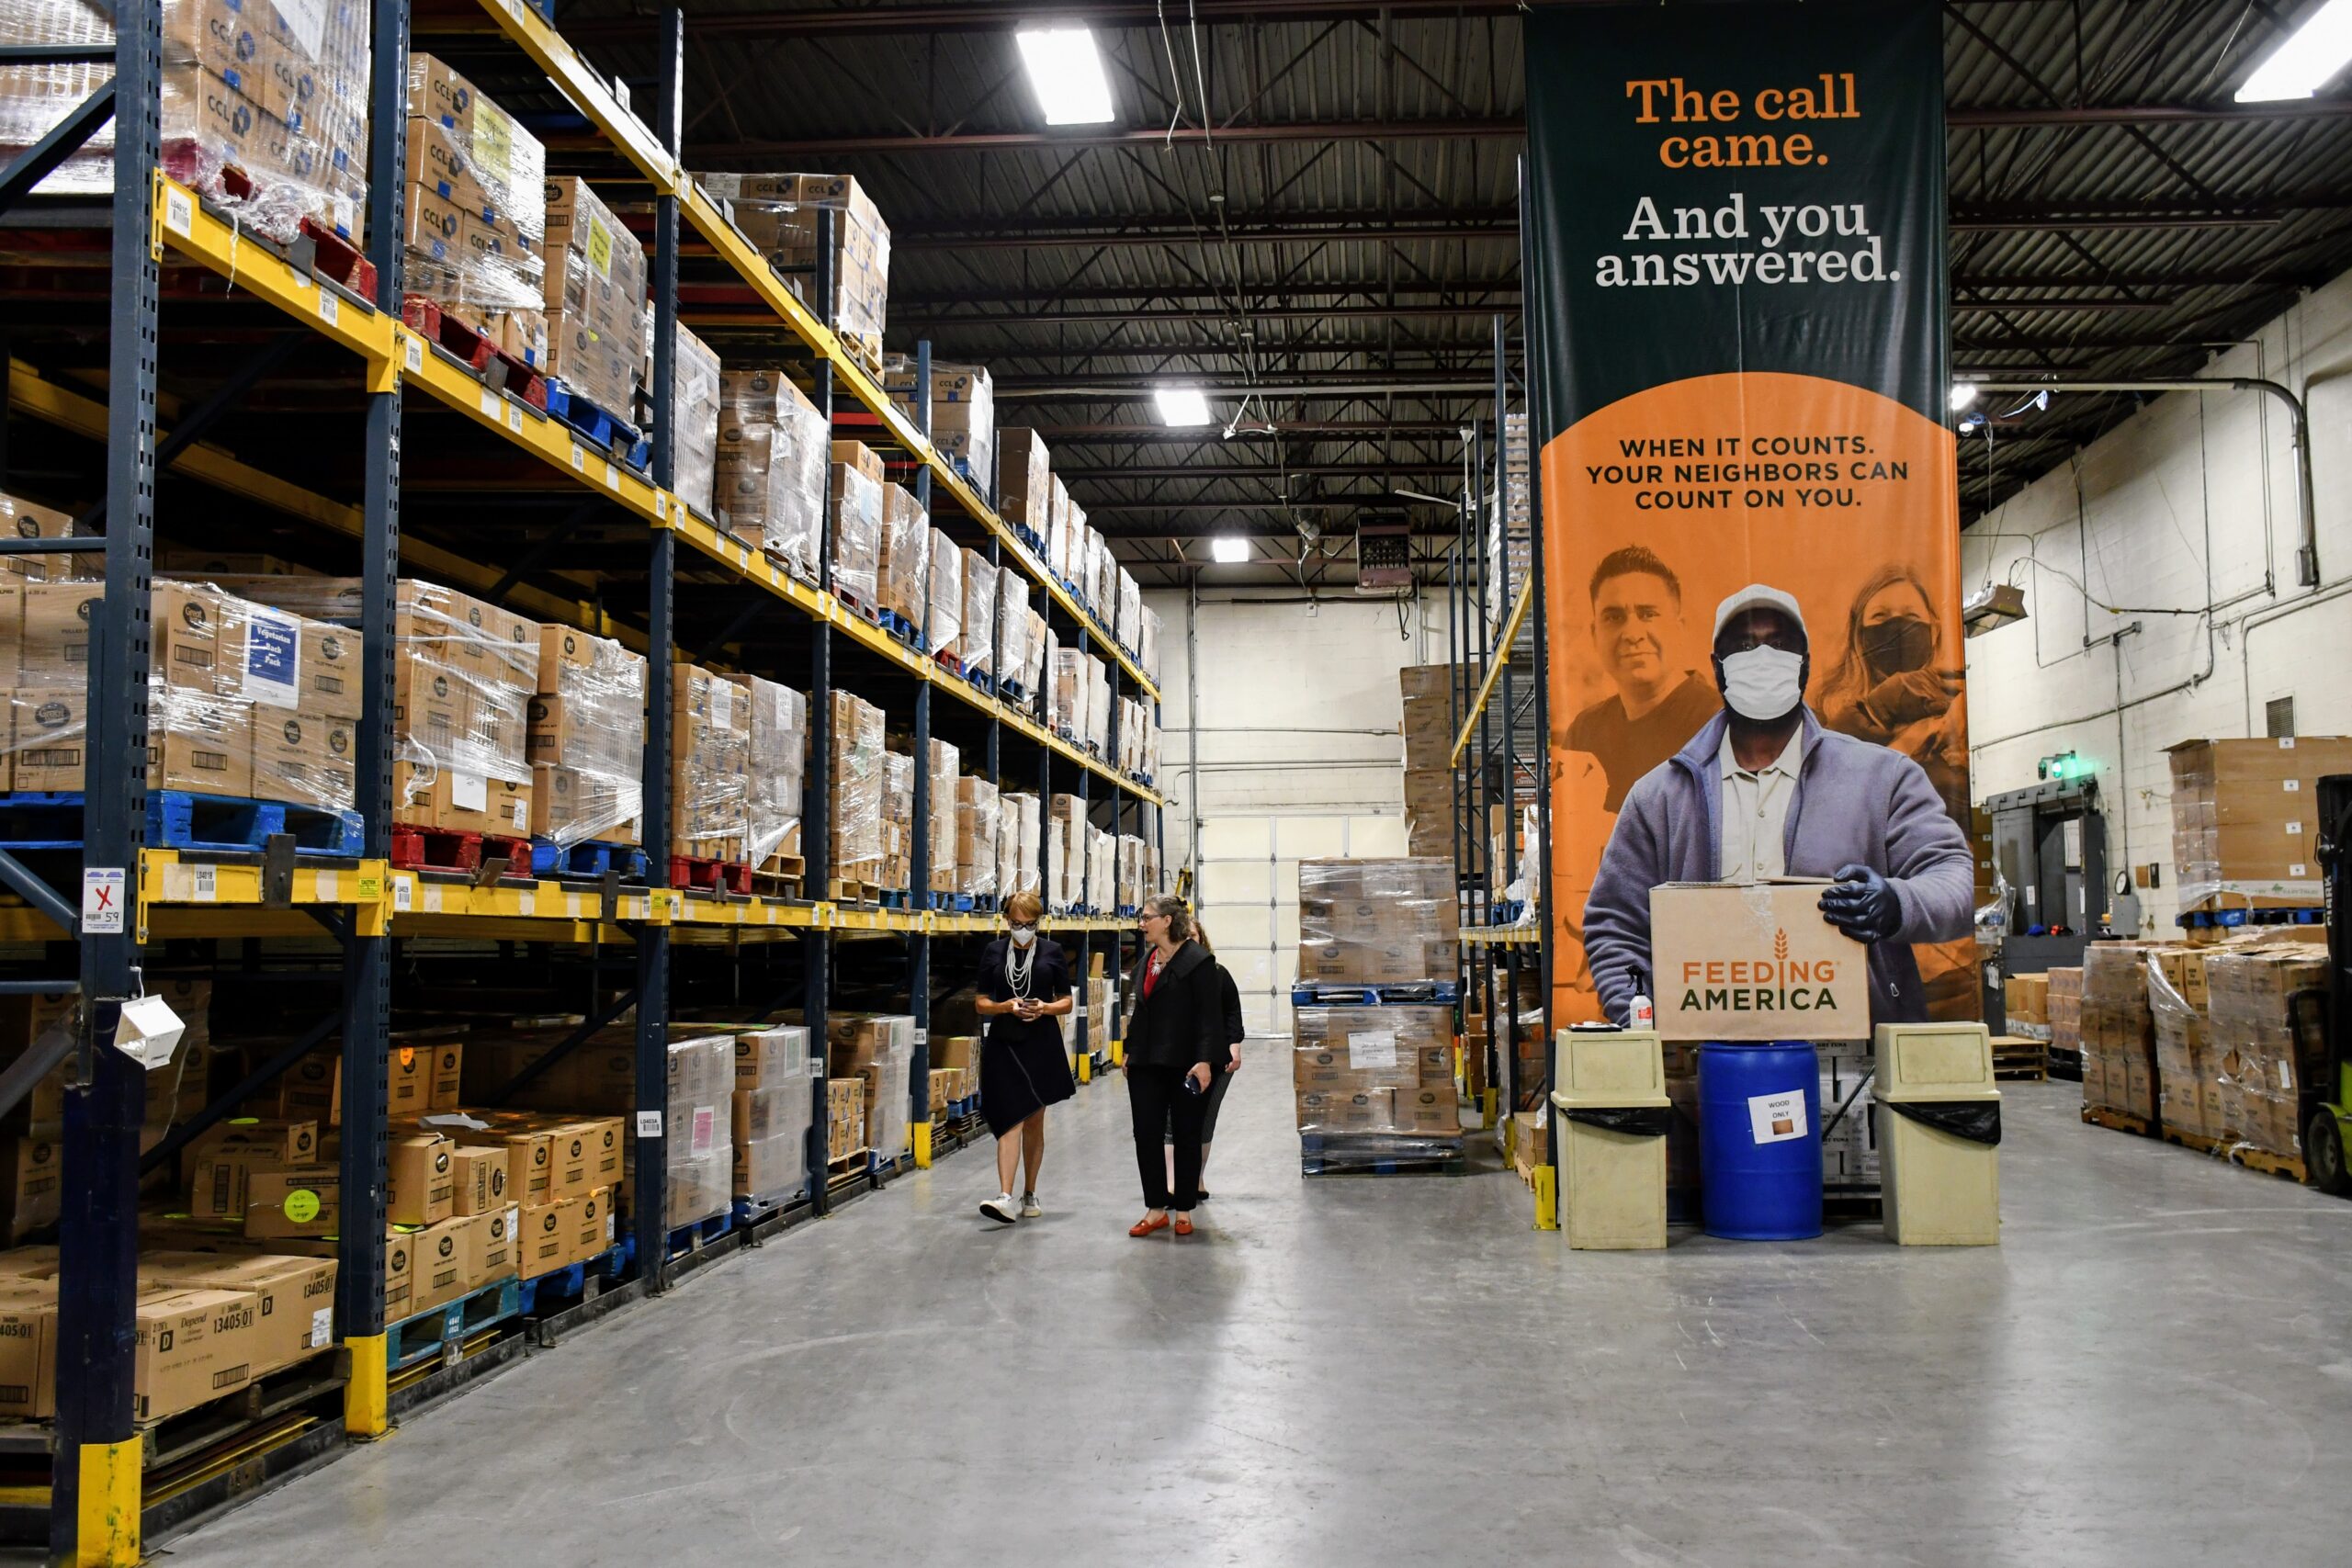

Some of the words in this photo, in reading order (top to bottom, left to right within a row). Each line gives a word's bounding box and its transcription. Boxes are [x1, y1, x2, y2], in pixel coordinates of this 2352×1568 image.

[275, 62, 294, 88] CCL
[434, 80, 451, 101] CCL
[1626, 78, 1739, 123] The
[1755, 73, 1860, 120] call
[208, 96, 230, 122] CCL
[430, 144, 448, 165] CCL
[1659, 133, 1828, 168] came.
[756, 184, 775, 192] CCL
[808, 186, 826, 194] CCL
[423, 208, 441, 229] CCL
[1623, 193, 1748, 241] And
[1759, 204, 1869, 248] you
[1596, 236, 1901, 287] answered.
[1620, 439, 1704, 457] WHEN
[1717, 438, 1740, 456] IT
[1752, 436, 1874, 456] COUNTS.
[1587, 466, 1662, 484] YOUR
[1675, 462, 1838, 482] NEIGHBORS
[1850, 462, 1908, 480] CAN
[1635, 491, 1733, 510] COUNT
[1744, 490, 1784, 507] ON
[1796, 489, 1861, 508] YOU.
[257, 627, 291, 644] Vegetarian
[105, 911, 119, 922] 59
[1683, 960, 1836, 987] FEEDING
[1679, 987, 1838, 1011] AMERICA
[304, 1280, 324, 1299] 13405
[325, 1277, 334, 1291] 01
[180, 1312, 208, 1328] Depend
[214, 1314, 241, 1334] 13405
[243, 1310, 254, 1325] 01
[20, 1325, 31, 1337] 01
